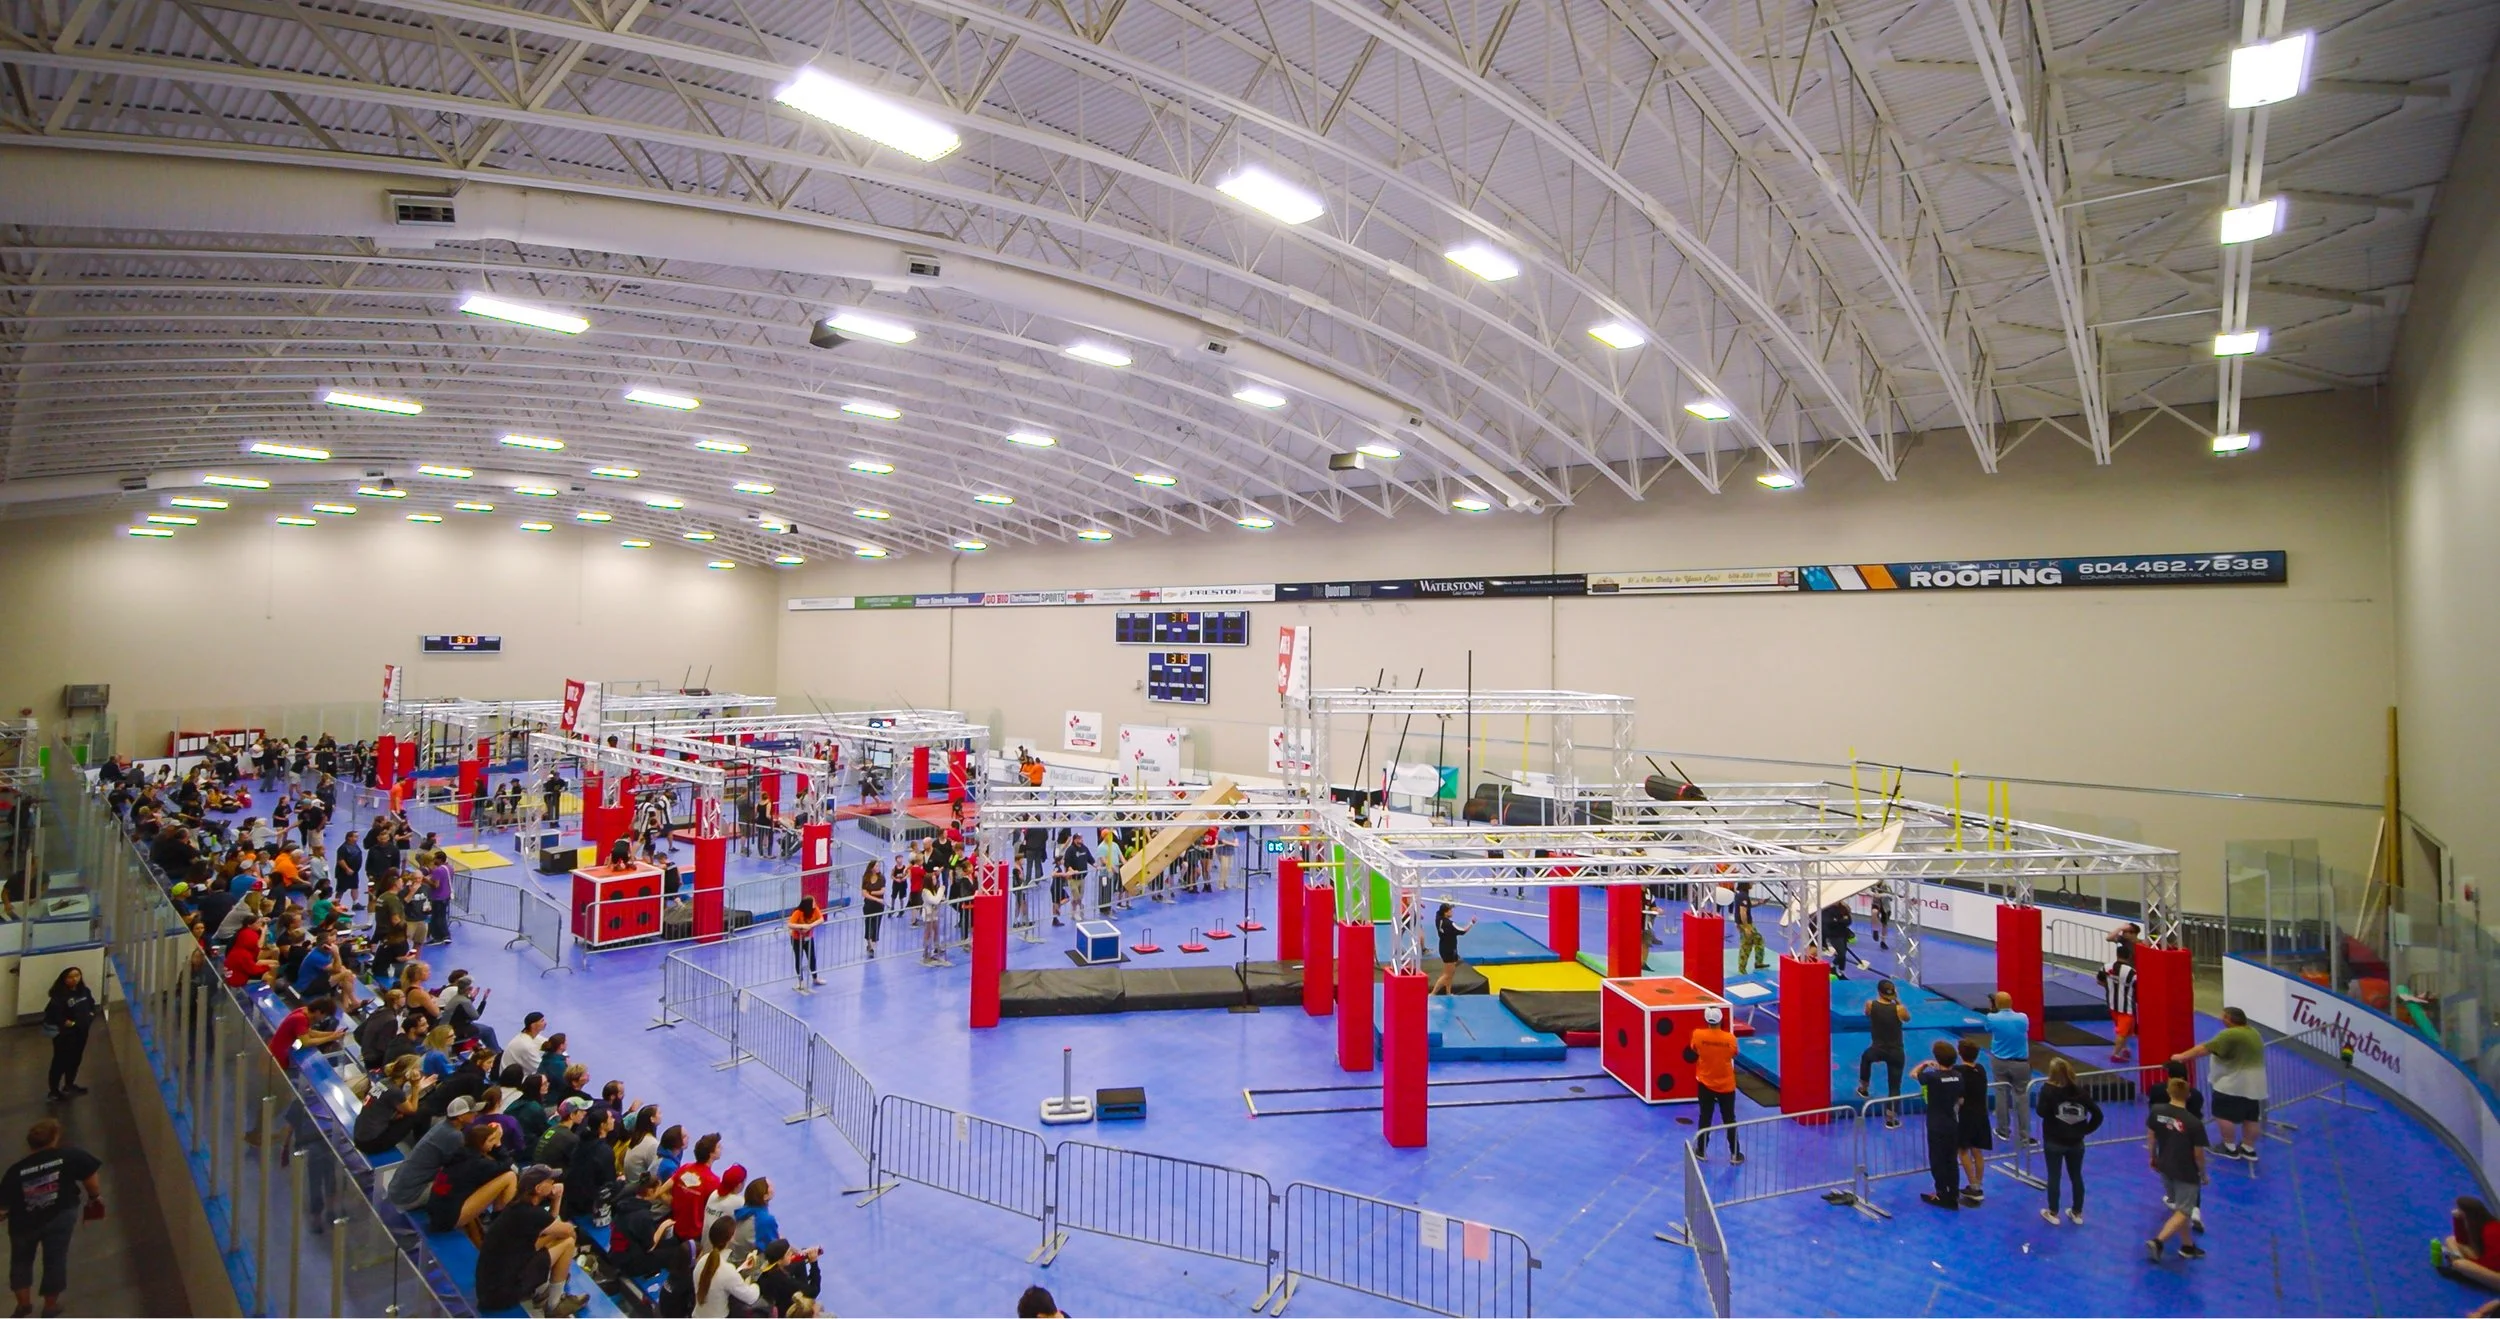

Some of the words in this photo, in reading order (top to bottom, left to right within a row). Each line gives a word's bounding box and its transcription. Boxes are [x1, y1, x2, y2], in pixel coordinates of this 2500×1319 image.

[2078, 558, 2269, 574] 604.462.7638
[1909, 568, 2062, 587] ROOFING
[1419, 580, 1484, 592] WATERSTONE
[1040, 593, 1065, 603] SPORTS
[1910, 897, 1950, 912] nda
[2291, 993, 2327, 1036] Tim
[2331, 1010, 2401, 1074] Hortons
